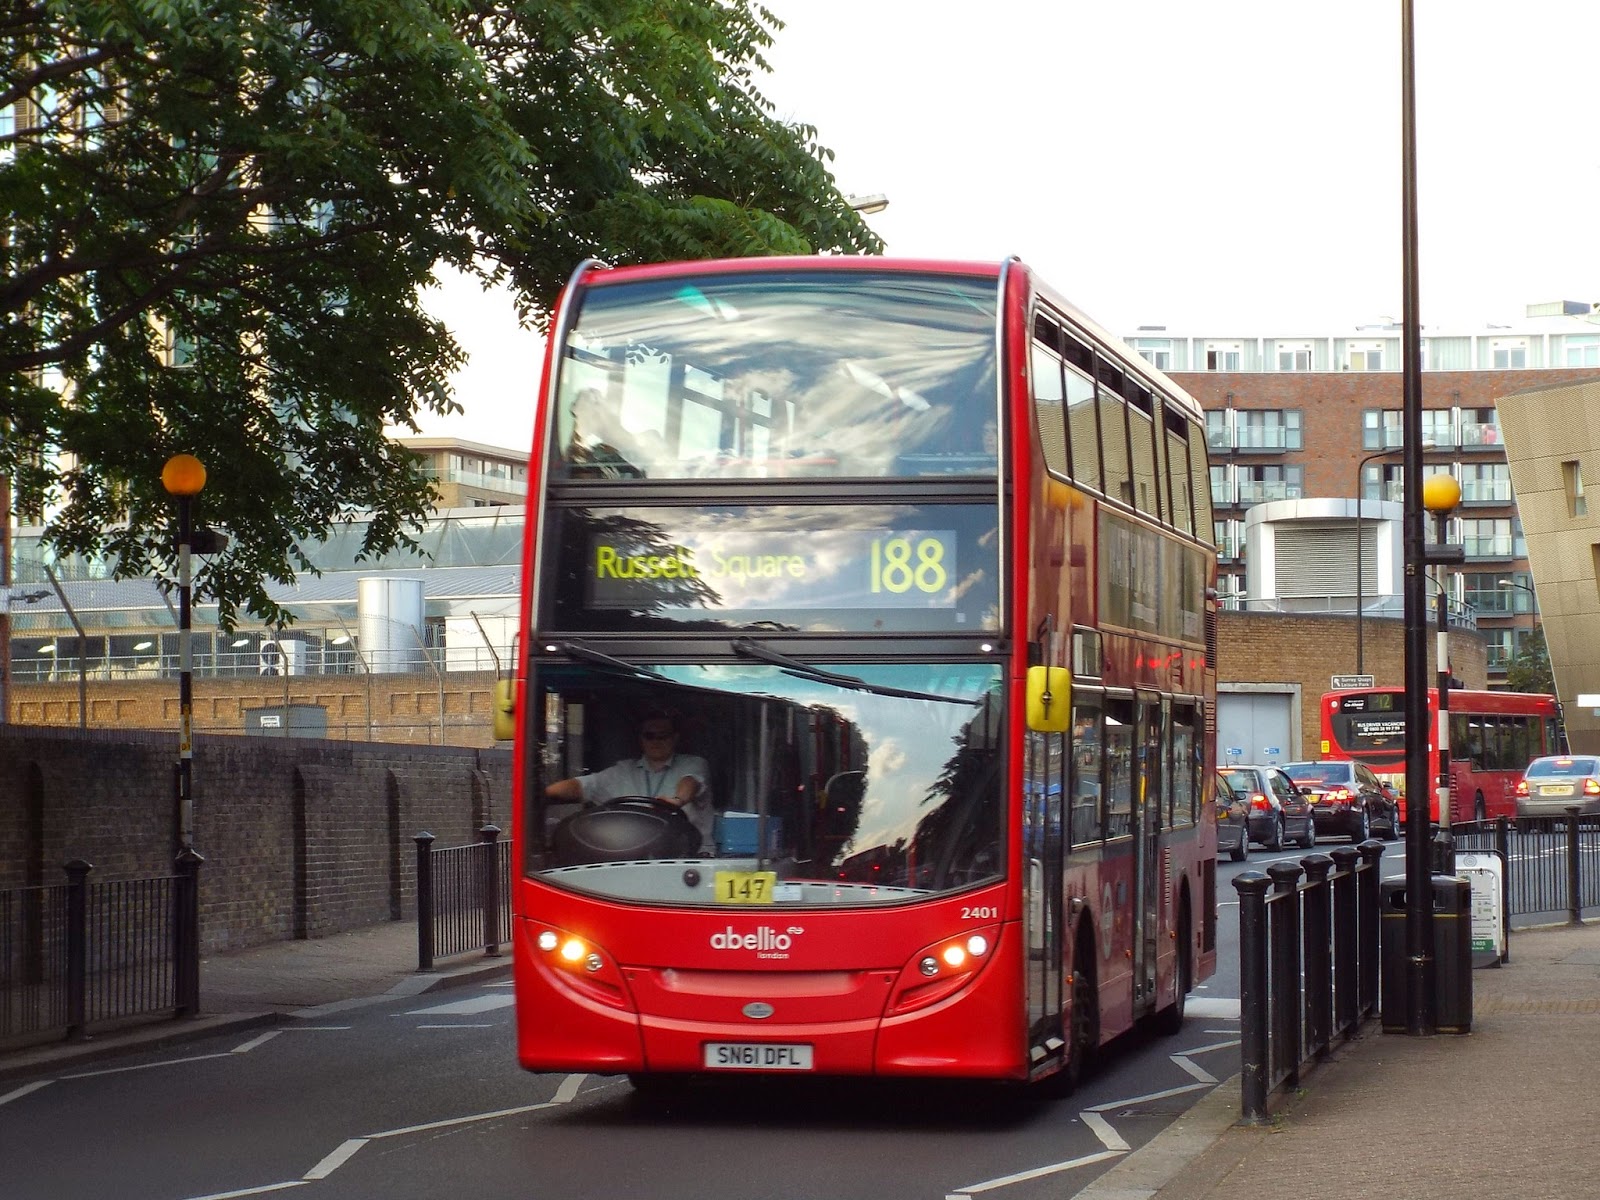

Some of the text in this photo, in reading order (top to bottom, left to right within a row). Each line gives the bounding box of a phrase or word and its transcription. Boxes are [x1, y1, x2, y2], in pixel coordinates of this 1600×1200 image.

[711, 546, 805, 587] Square
[871, 538, 947, 593] 188
[726, 879, 766, 899] 147
[960, 907, 998, 919] 2401
[710, 926, 792, 951] abellio
[718, 1047, 801, 1066] SN61 DFL
